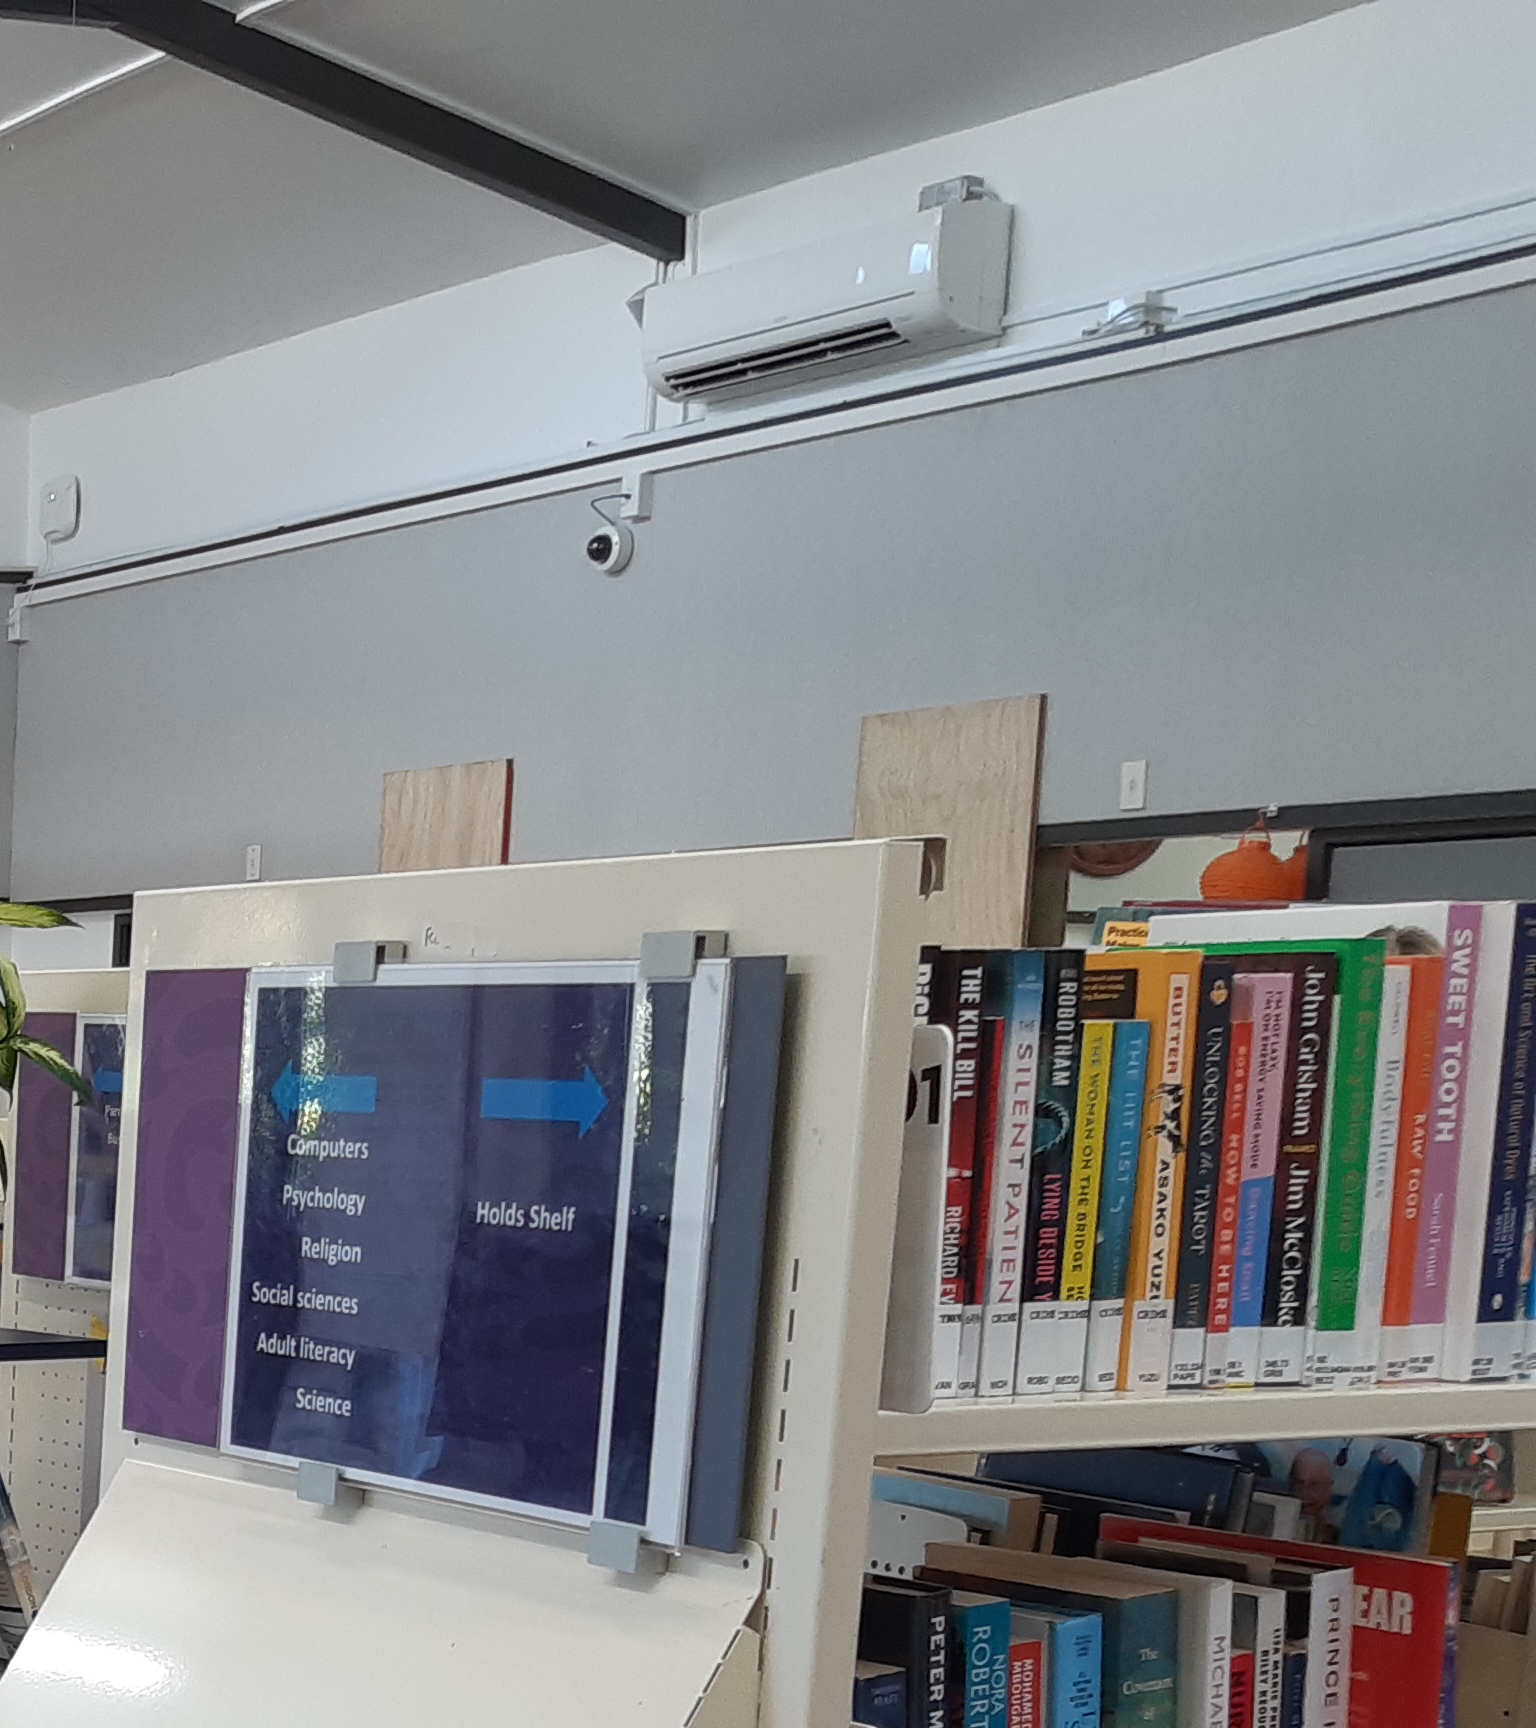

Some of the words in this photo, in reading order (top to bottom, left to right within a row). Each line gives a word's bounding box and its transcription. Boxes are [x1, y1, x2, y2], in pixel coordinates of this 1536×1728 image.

[959, 965, 984, 1004] THE
[1300, 965, 1327, 1028] John
[1444, 928, 1474, 1029] SWEET
[956, 1009, 980, 1054] KILL
[1051, 981, 1078, 1087] ROBOTHAM
[1090, 1036, 1104, 1068] THE
[1166, 985, 1185, 1075] BUTTER
[952, 1058, 976, 1103] BILL
[1126, 1038, 1142, 1075] THE
[1008, 1042, 1034, 1170] SILENT
[1084, 1073, 1101, 1140] WOMAN
[1199, 1026, 1225, 1147] UNLOCKING
[1290, 1033, 1322, 1137] Grisham
[1432, 1041, 1466, 1143] TOOTH
[286, 1132, 370, 1161] Computers
[1082, 1145, 1094, 1170] ON
[1117, 1140, 1133, 1183] LIST
[1225, 1133, 1241, 1186] HOW
[1410, 1113, 1428, 1160] RAW
[282, 1184, 366, 1217] Psychology
[1077, 1176, 1092, 1207] THE
[1152, 1158, 1173, 1238] ASAKO
[1222, 1194, 1237, 1223] TO
[1285, 1162, 1311, 1211] Jim
[1404, 1169, 1423, 1221] FOOD
[475, 1200, 525, 1231] Holds
[528, 1203, 576, 1232] Shelf
[1190, 1184, 1212, 1255] TAROT
[1219, 1229, 1234, 1252] BE
[300, 1236, 362, 1266] Religion
[998, 1182, 1023, 1304] PATIEN
[1071, 1213, 1088, 1273] BRIDGE
[251, 1280, 294, 1308] Social
[296, 1286, 359, 1316] sciences
[1213, 1264, 1231, 1327] HERE
[256, 1331, 297, 1358] Adult
[299, 1337, 356, 1371] literacy
[294, 1386, 353, 1417] Science
[1353, 1583, 1414, 1635] EAR
[928, 1615, 947, 1702] PETER
[1139, 1647, 1159, 1661] The
[1323, 1596, 1340, 1707] PRINCE
[989, 1653, 1007, 1716] NORA
